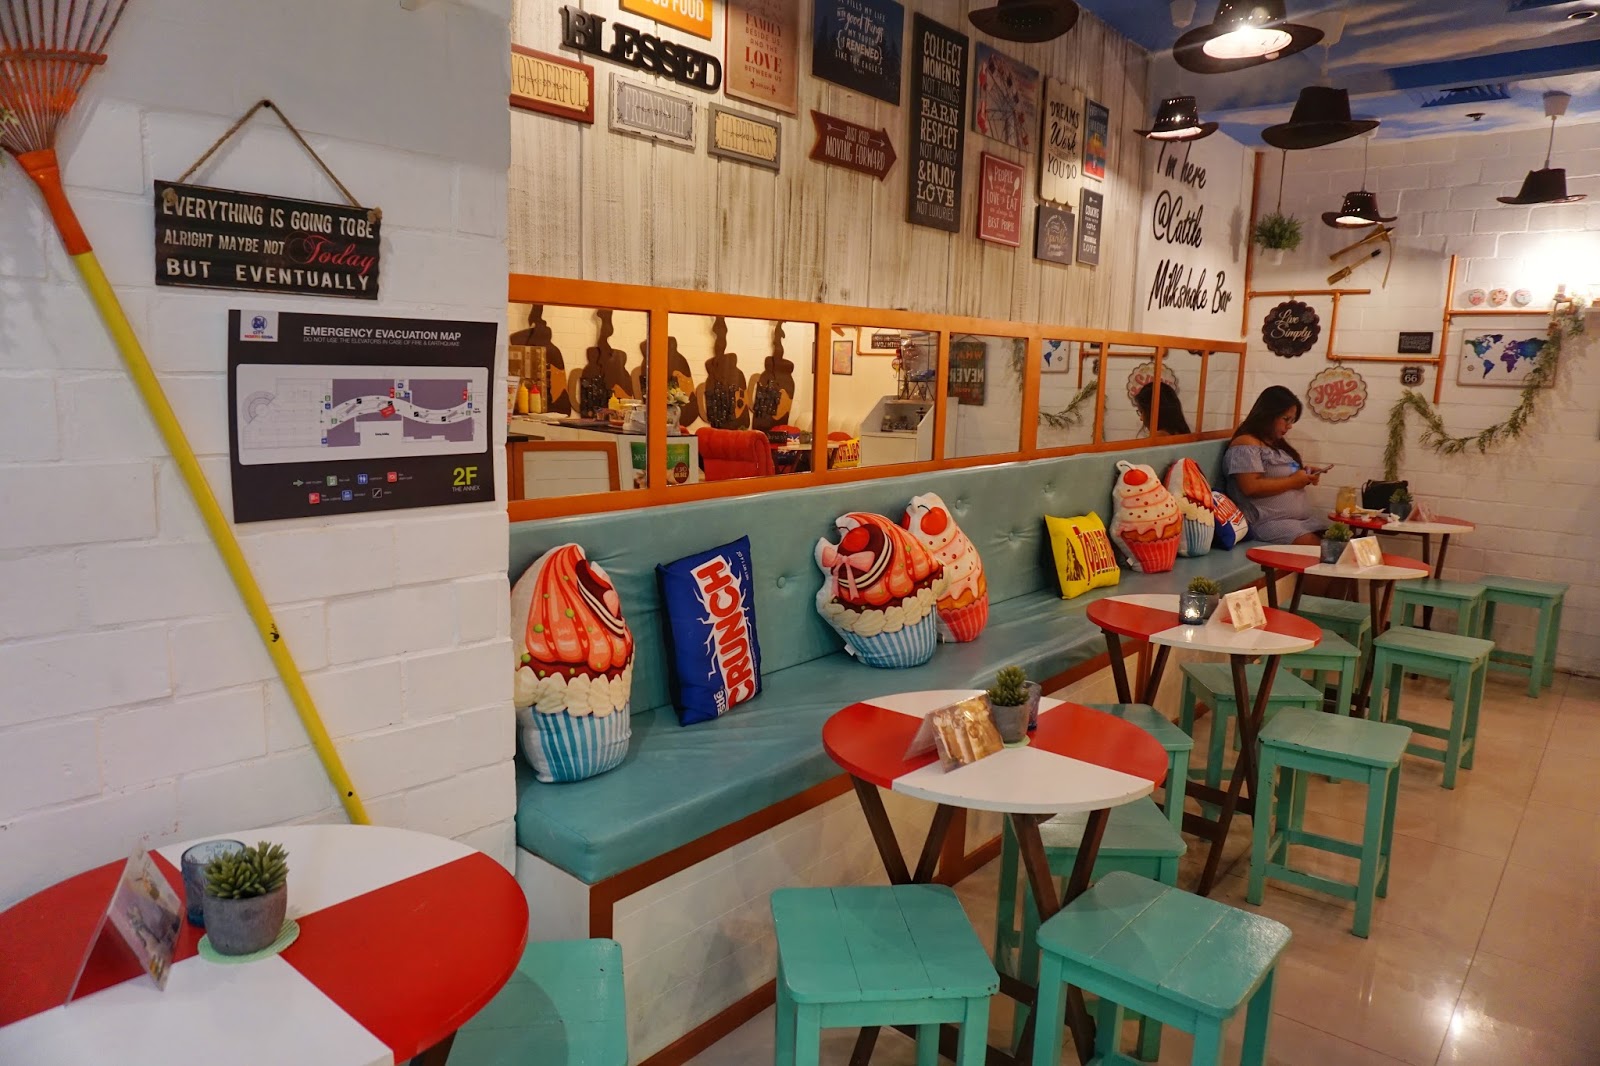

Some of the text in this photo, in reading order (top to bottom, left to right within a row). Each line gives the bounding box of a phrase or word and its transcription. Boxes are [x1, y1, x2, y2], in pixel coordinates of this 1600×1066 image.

[562, 5, 722, 91] BLESSED
[745, 27, 769, 41] BESIDE
[745, 46, 782, 73] LOVE
[835, 49, 848, 60] LIKE
[845, 37, 880, 60] RENEWED
[923, 30, 962, 69] COLLECT
[923, 55, 960, 87] MOMENTS
[922, 75, 960, 104] NOT THINGS
[624, 86, 688, 136] FRIENDSHIP
[921, 96, 958, 127] EARN
[1050, 101, 1079, 129] DREAMS
[845, 125, 858, 142] JUST
[920, 116, 959, 151] RESPECT
[1050, 121, 1077, 155] Work
[825, 135, 886, 171] MOVING FORWARD
[919, 141, 957, 166] NOT MONEY
[1179, 141, 1207, 190] here
[994, 165, 1013, 184] PEOPLE
[916, 180, 955, 208] LOVE
[986, 189, 999, 206] LOVE
[1006, 194, 1018, 212] EAT
[162, 194, 264, 227] EVERYTHING
[270, 207, 285, 228] IS
[290, 211, 332, 234] GOING
[916, 200, 954, 222] NOT LUXURIES
[987, 215, 999, 230] BEST
[164, 229, 285, 255] ALRIGHT MAYBE NOT
[303, 234, 375, 275] Today
[166, 257, 369, 291] BUT EVENTUALLY
[1147, 259, 1232, 315] Milkshake Bar
[1278, 308, 1300, 325] Live
[303, 326, 462, 341] EMERGENCY EVACUATION MAP
[1270, 320, 1312, 343] Simply
[1404, 374, 1418, 383] 66
[453, 466, 478, 486] 2F
[696, 561, 755, 709] CRUNCH
